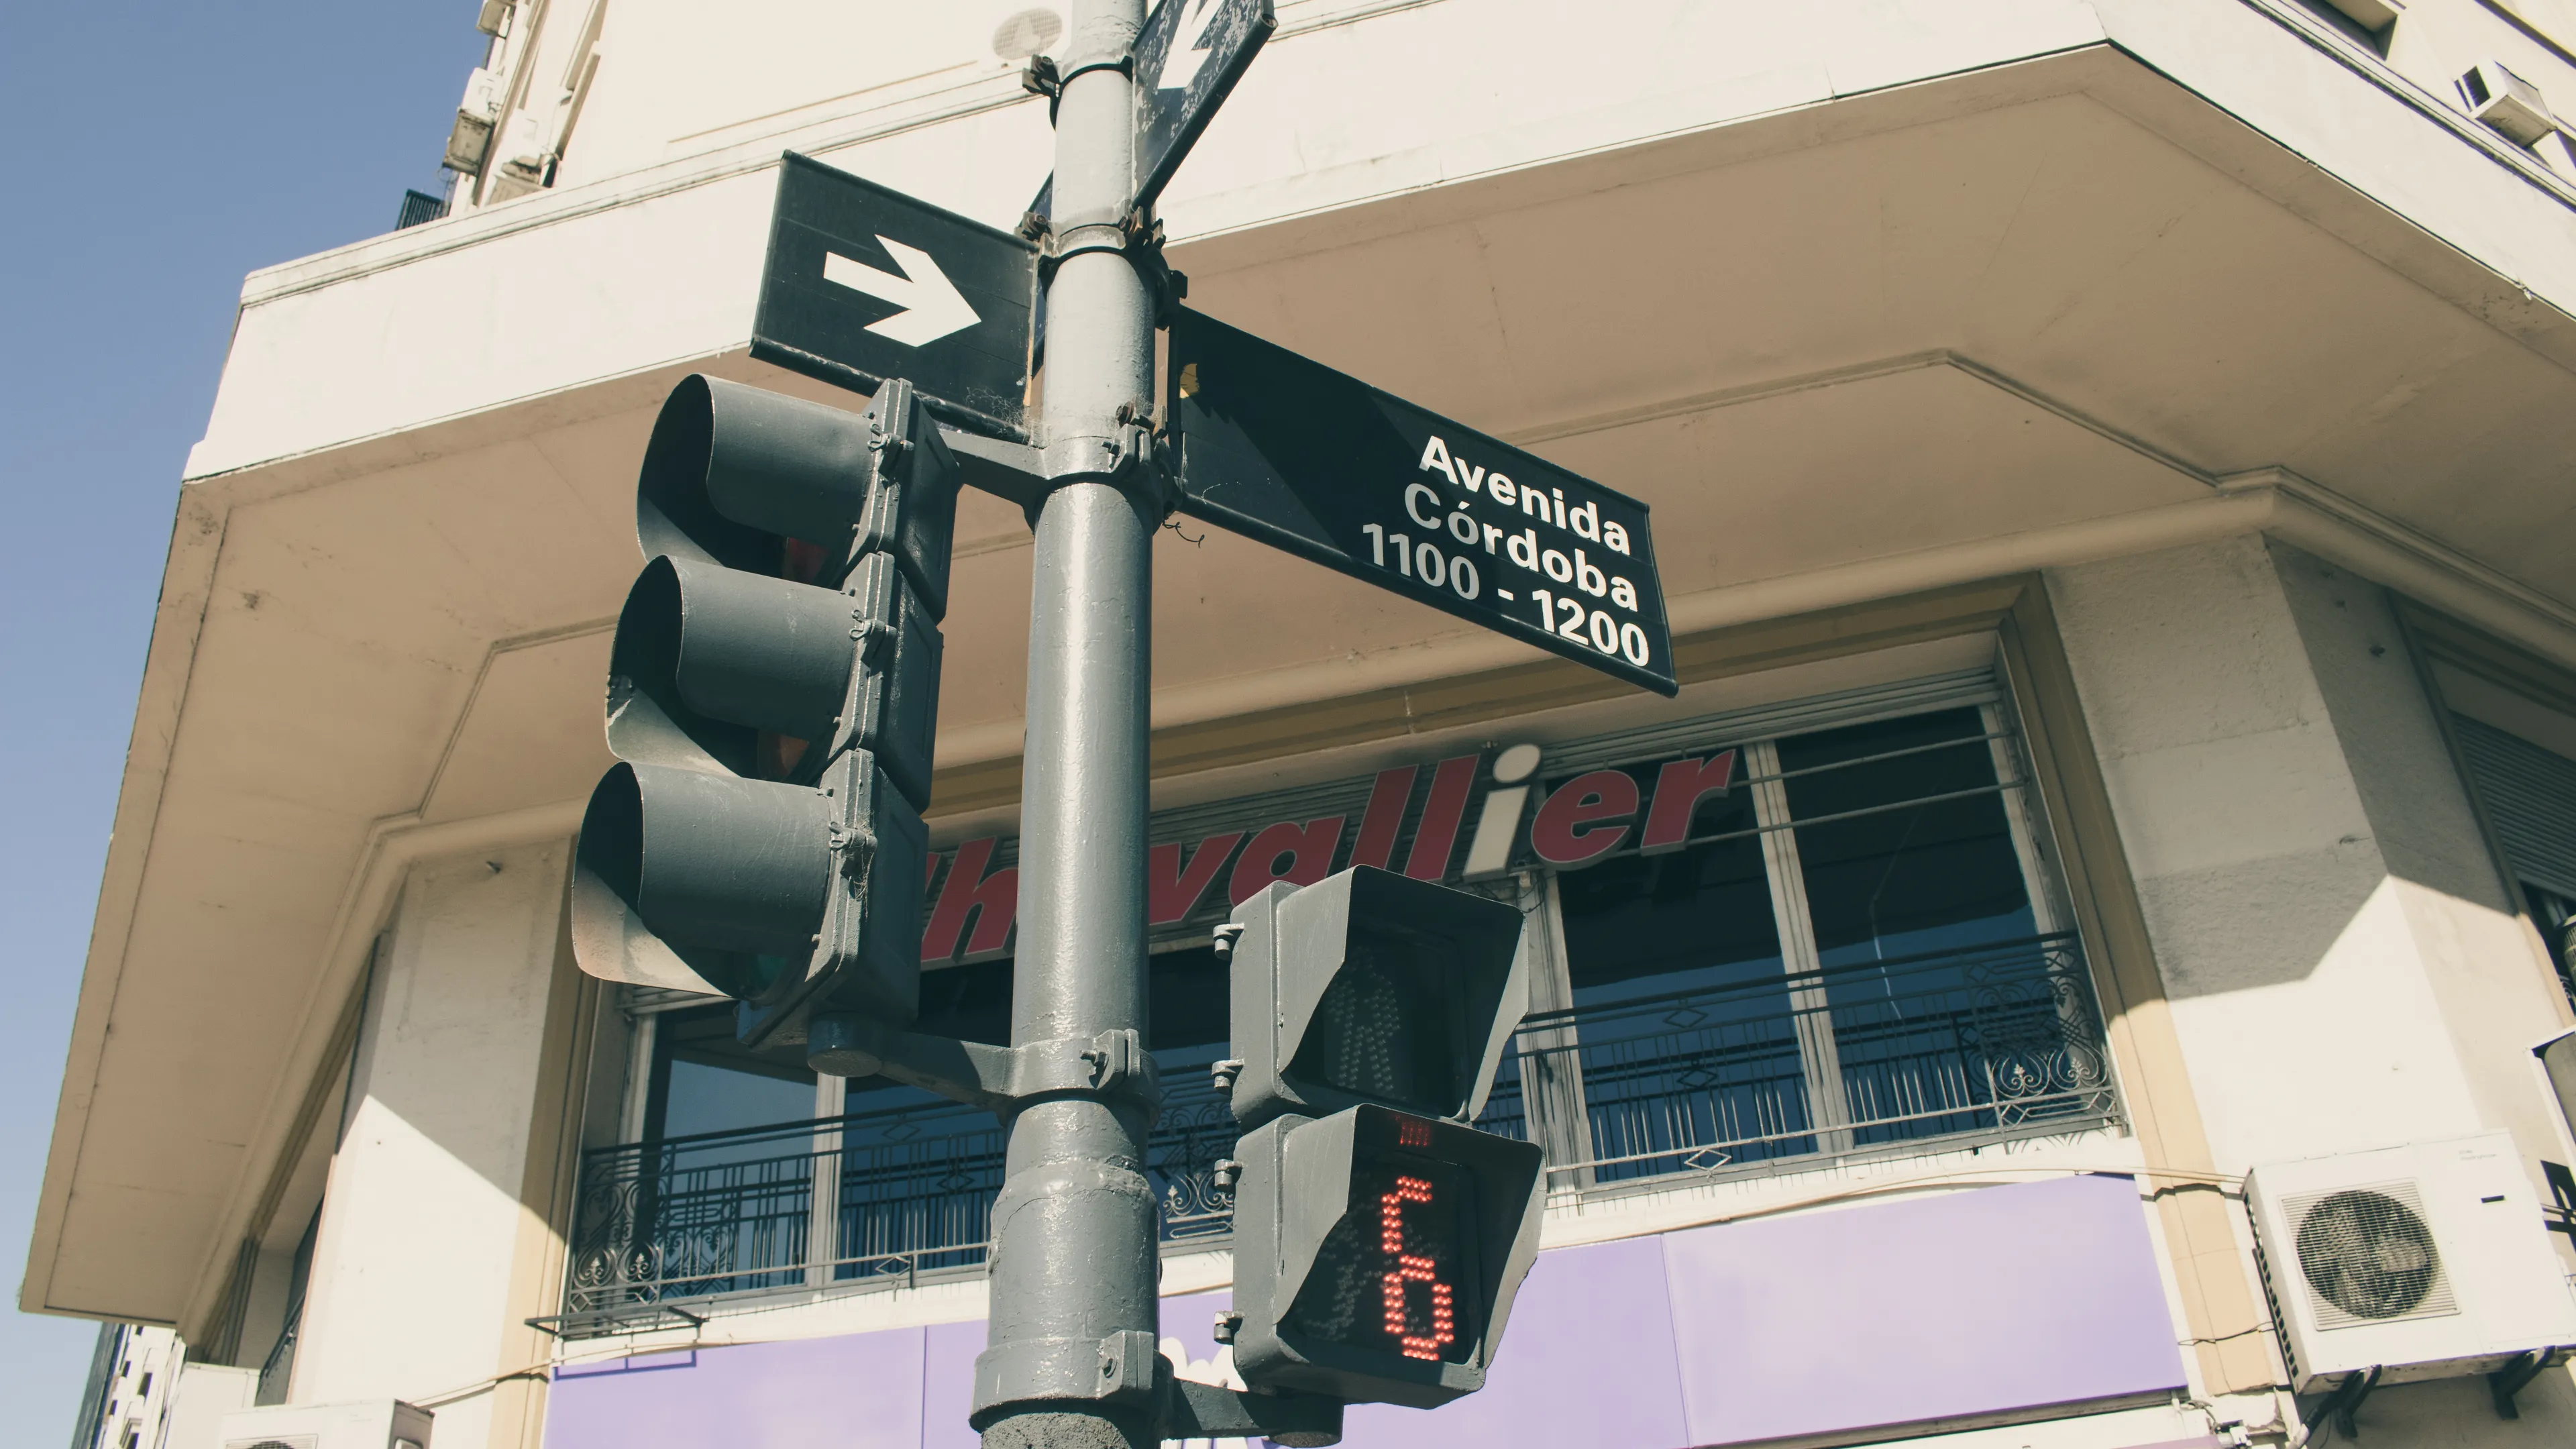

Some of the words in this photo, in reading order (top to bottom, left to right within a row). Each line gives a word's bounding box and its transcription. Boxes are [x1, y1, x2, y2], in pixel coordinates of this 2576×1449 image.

[1405, 483, 1639, 612] Córdoba
[1419, 435, 1631, 556] Avenida
[1362, 523, 1481, 600] 1100
[1532, 589, 1650, 667] 1200
[921, 743, 1737, 963] hvallier
